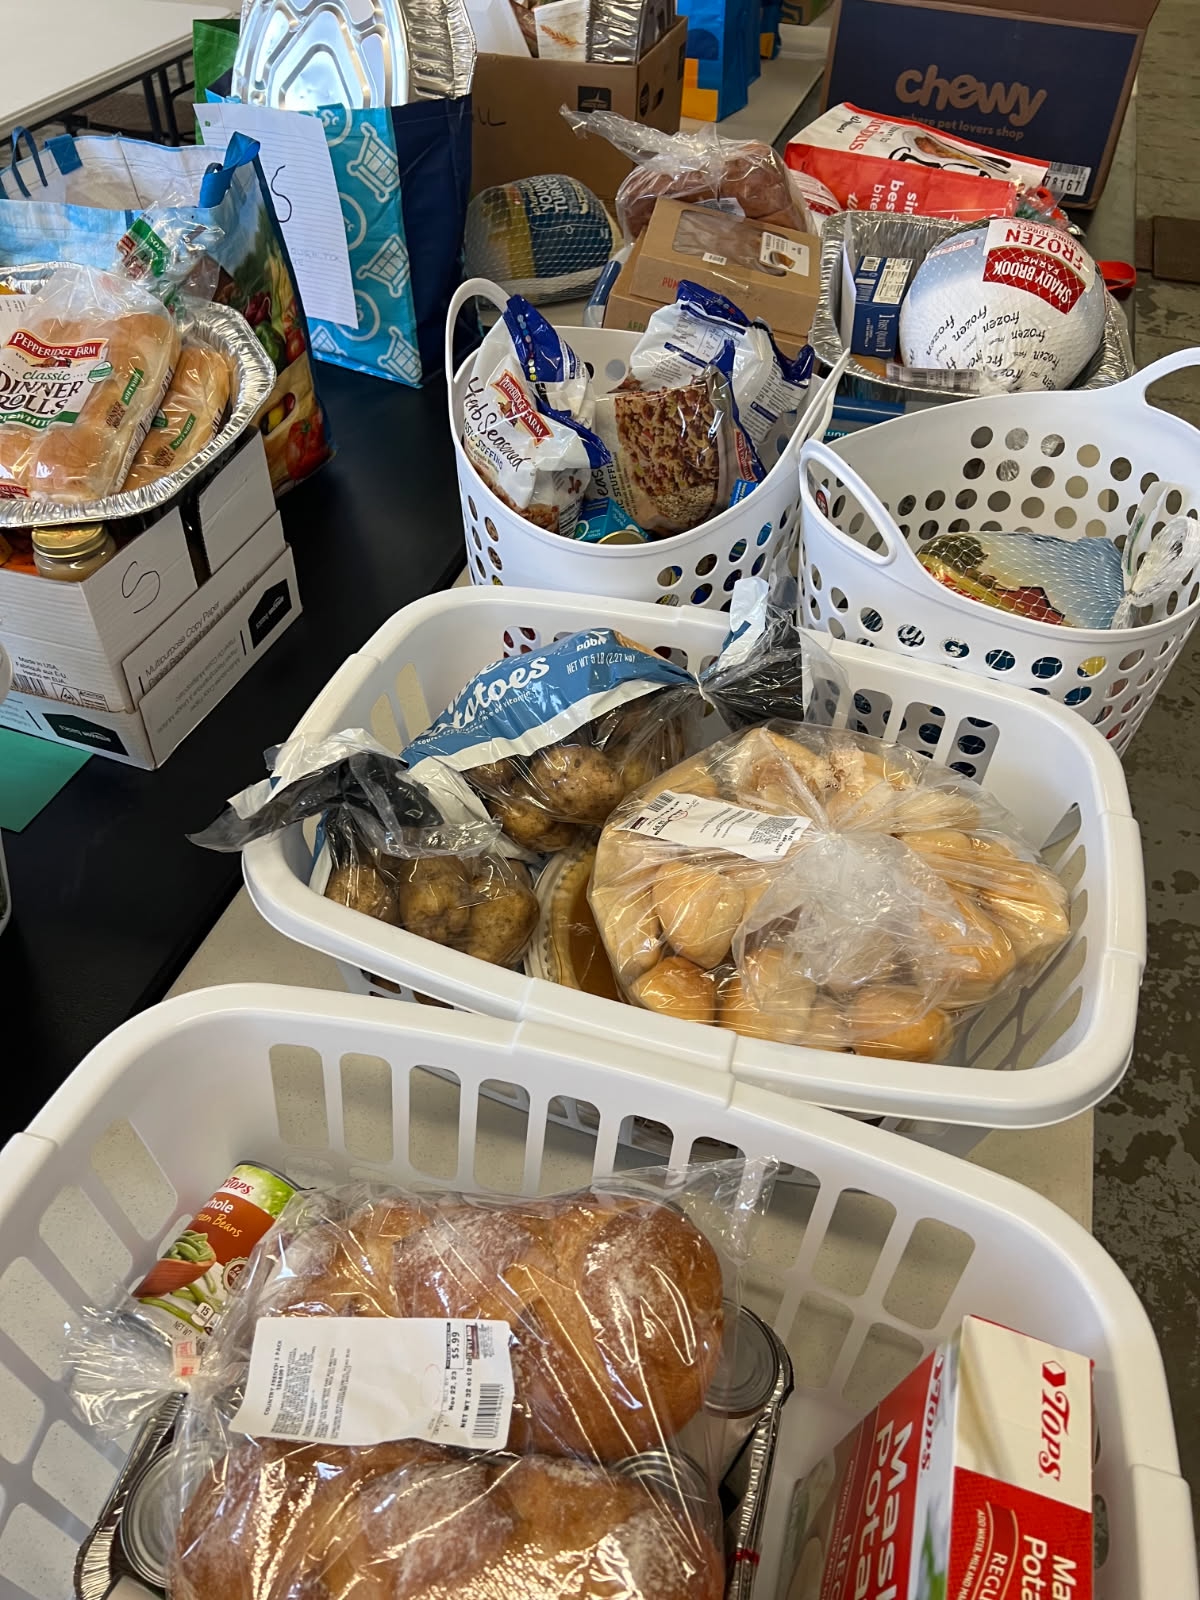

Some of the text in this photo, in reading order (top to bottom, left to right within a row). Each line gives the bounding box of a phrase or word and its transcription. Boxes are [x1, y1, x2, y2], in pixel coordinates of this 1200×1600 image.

[896, 64, 1047, 126] chewy
[937, 119, 957, 131] pet
[960, 121, 994, 136] lovers
[996, 125, 1024, 141] shop
[548, 176, 569, 213] TURKE
[886, 179, 905, 213] bes
[1005, 228, 1083, 271] FROZEN
[1023, 255, 1060, 274] FARMS
[993, 260, 1072, 303] SHADY BROOK
[952, 304, 988, 342] frozen
[982, 310, 1020, 334] frozen
[1011, 328, 1046, 343] frozen
[13, 332, 96, 358] PEPPERIDGE FARM
[0, 370, 83, 399] DINNER
[23, 370, 71, 381] classic
[464, 376, 489, 421] Herb
[501, 376, 544, 437] PEPPERIDGE FARM
[606, 460, 622, 498] STUFFI
[121, 560, 161, 614] S
[566, 663, 579, 675] NET
[580, 658, 589, 671] WT
[590, 656, 596, 666] 5
[423, 656, 550, 737] otatoes
[213, 1213, 243, 1238] Beans
[201, 1305, 212, 1316] 15
[174, 1320, 184, 1332] NET
[451, 1331, 460, 1359] $5.99
[263, 1387, 275, 1416] COUNTRY
[448, 1396, 456, 1411] Nov
[463, 1400, 471, 1411] WT
[465, 1387, 472, 1398] 32
[460, 1413, 469, 1428] NET
[922, 1379, 942, 1471] TOPS
[1038, 1388, 1071, 1483] TOPS
[976, 1508, 987, 1528] ADD
[969, 1554, 982, 1573] MILK
[1052, 1554, 1077, 1600] Ma
[962, 1571, 976, 1588] AND
